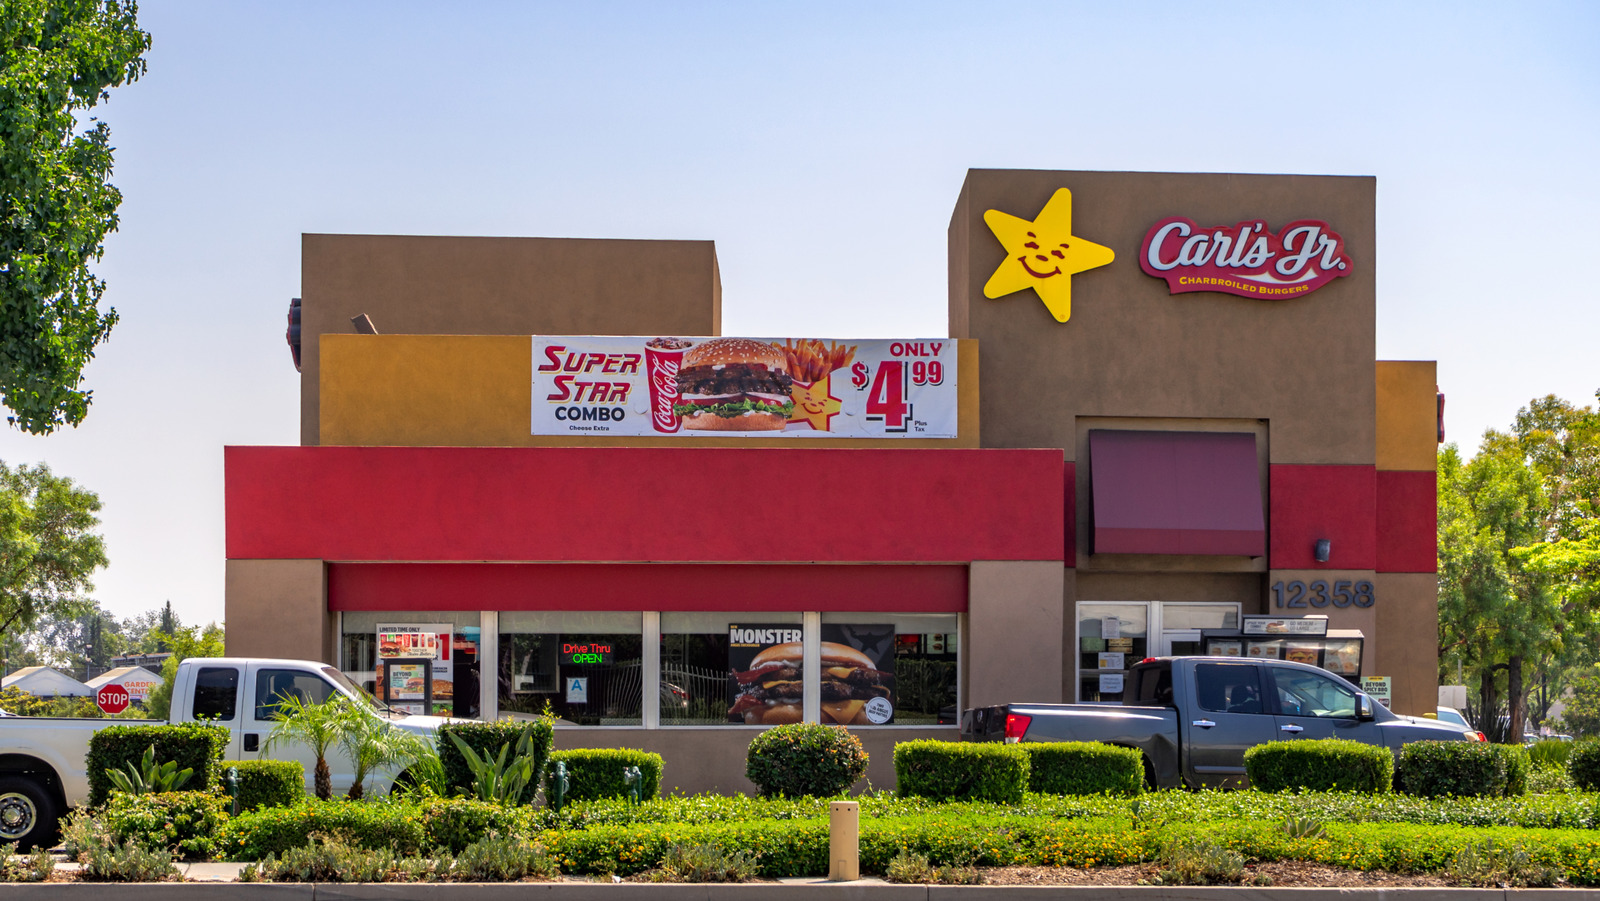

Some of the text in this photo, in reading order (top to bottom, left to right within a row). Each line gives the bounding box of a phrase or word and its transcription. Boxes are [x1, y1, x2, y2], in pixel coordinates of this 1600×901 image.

[1147, 221, 1346, 275] Carl's Jr.
[1179, 276, 1309, 295] CHARBROILED BURGERS
[890, 342, 942, 357] ONLY
[538, 345, 642, 375] SUPER
[547, 375, 632, 404] STAR
[555, 406, 625, 422] COMBO
[1271, 580, 1376, 608] 12358
[730, 629, 802, 644] MONSTER
[563, 643, 611, 654] Drive Thru
[572, 653, 602, 664] OPEN
[571, 679, 583, 691] A
[100, 692, 128, 705] STOP
